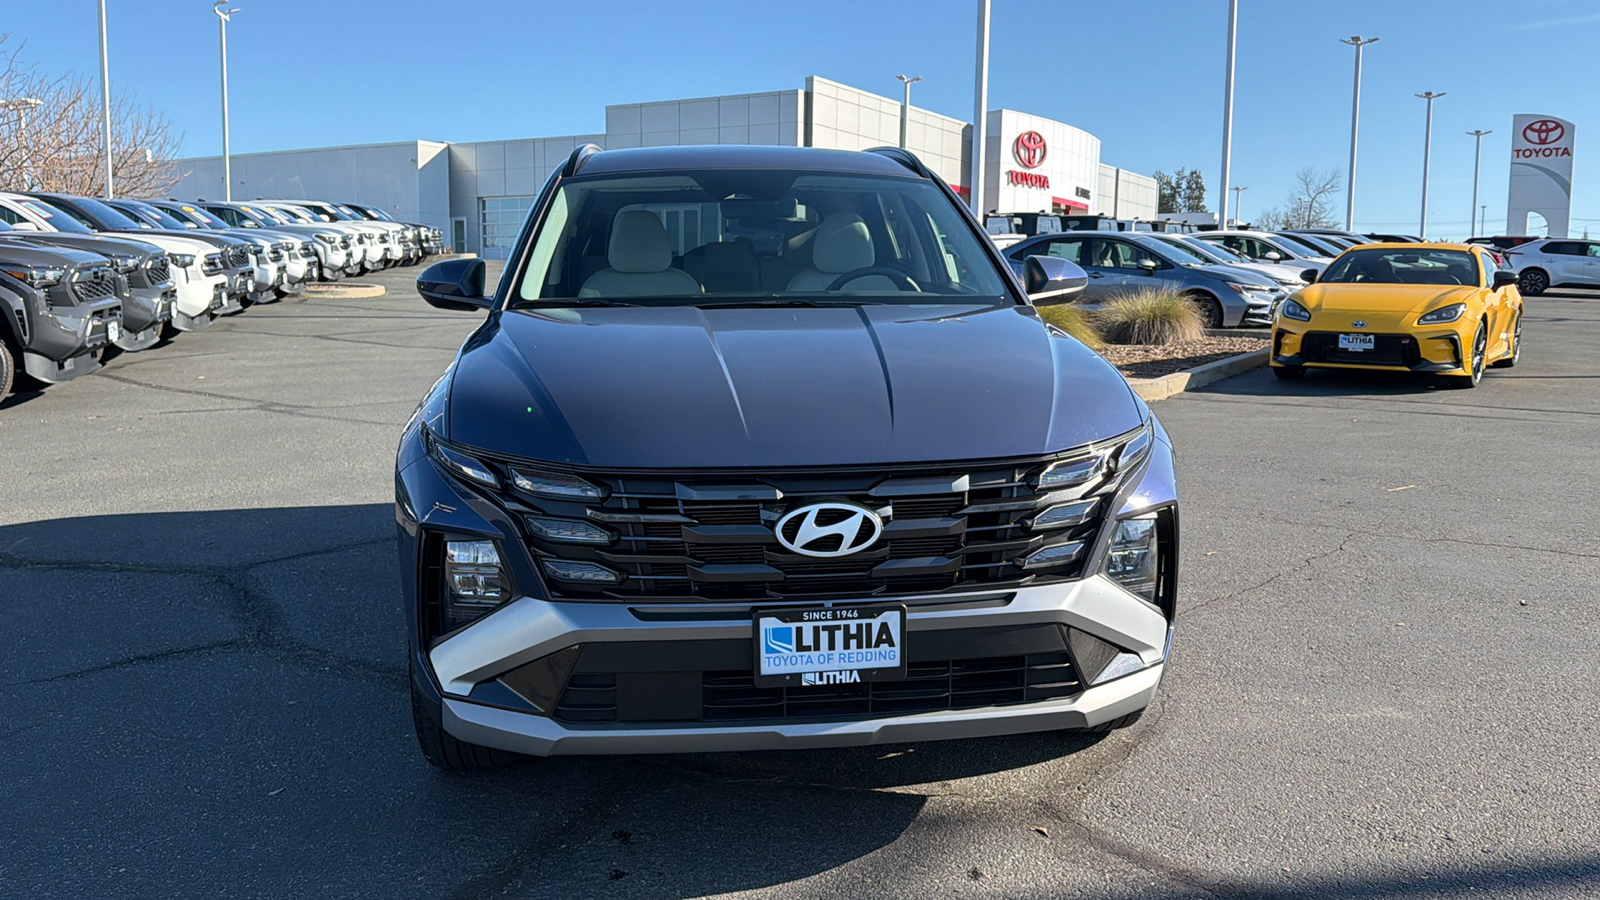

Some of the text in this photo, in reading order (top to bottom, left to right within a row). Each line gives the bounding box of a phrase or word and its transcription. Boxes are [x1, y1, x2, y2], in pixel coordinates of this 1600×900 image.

[1514, 147, 1571, 159] TOYOTA
[1008, 170, 1050, 189] TOYOTA
[803, 610, 859, 620] SINCE 1946
[795, 622, 896, 652] LITHIA
[765, 650, 896, 667] TOYOTA OF REDDING
[815, 670, 861, 685] LITHIA
